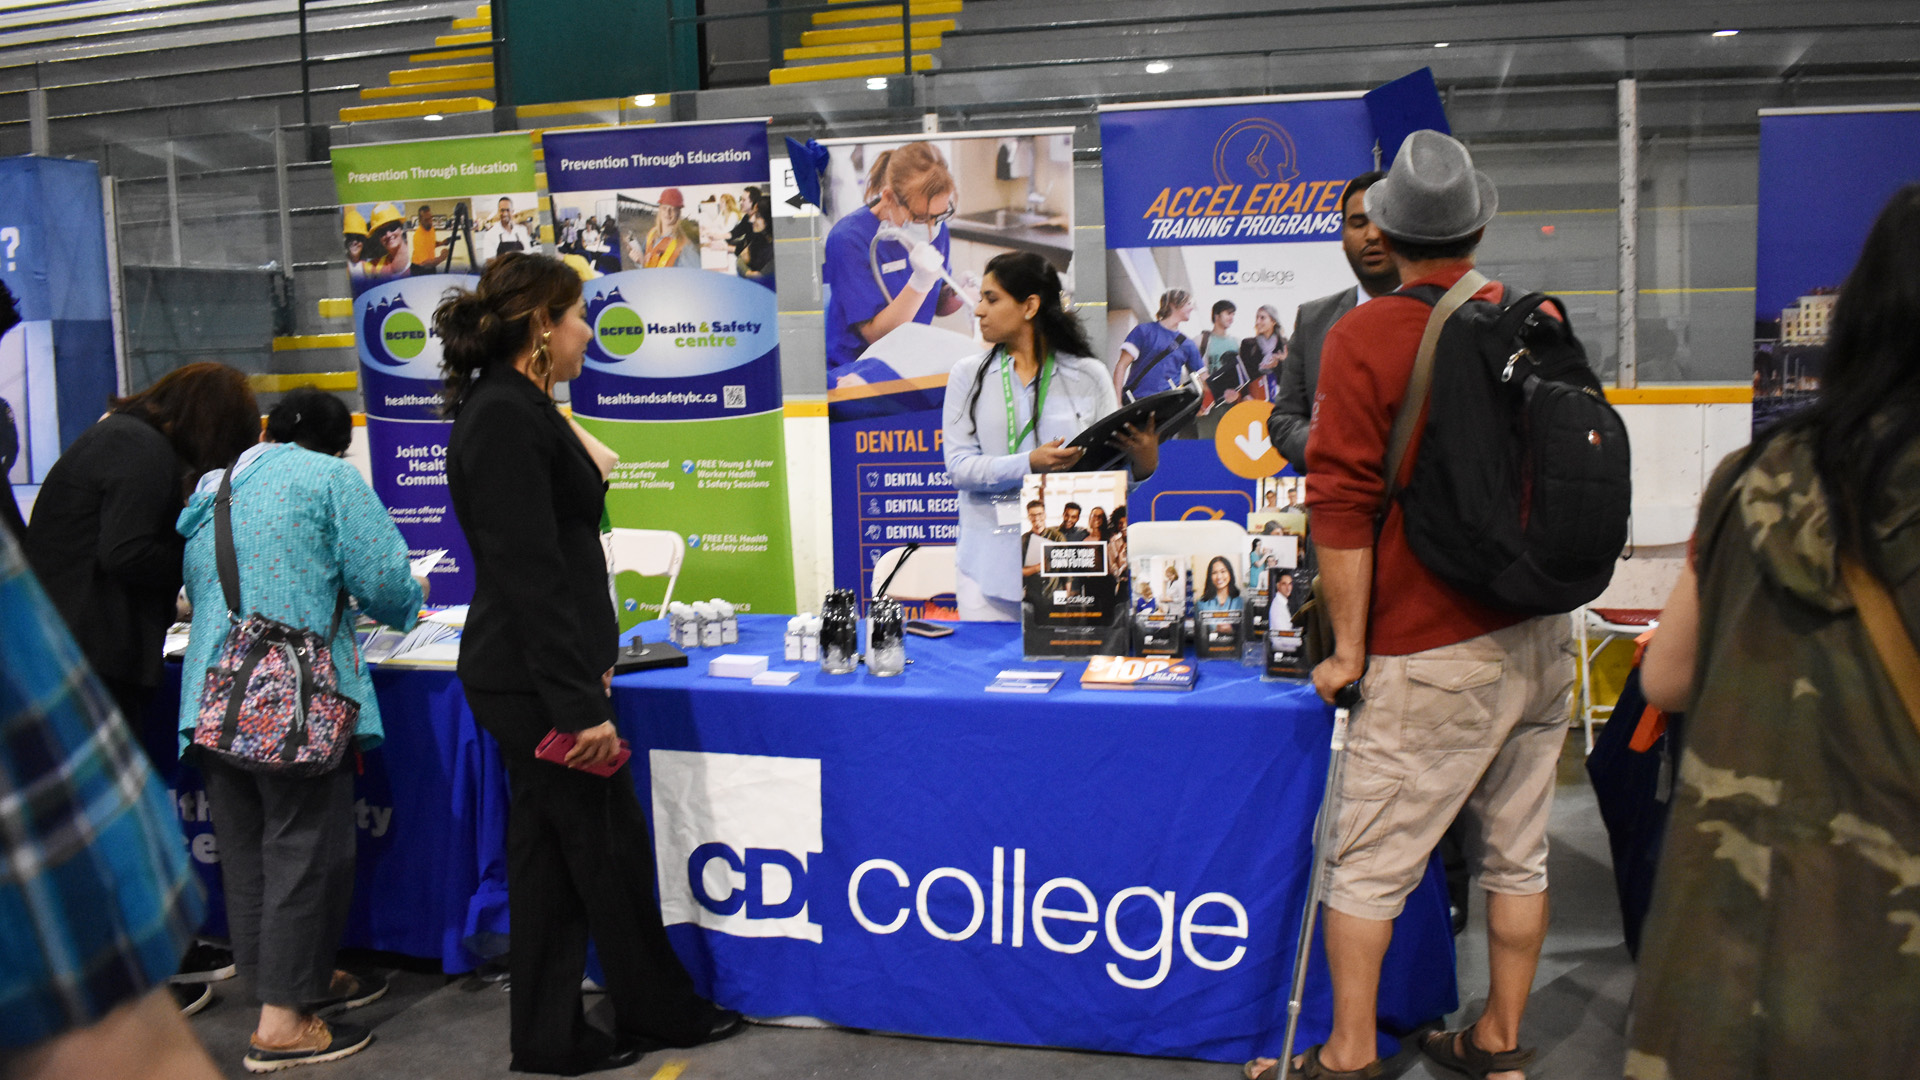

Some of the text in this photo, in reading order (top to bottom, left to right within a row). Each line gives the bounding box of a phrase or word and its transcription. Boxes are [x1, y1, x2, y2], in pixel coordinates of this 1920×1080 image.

[561, 149, 751, 171] Prevention Through Education
[348, 161, 517, 184] Prevention Through Education
[1148, 212, 1343, 240] TRAINING PROGRAMS
[600, 326, 643, 336] BCFED
[647, 320, 762, 334] Health & Safety
[386, 330, 425, 340] BCFED
[674, 334, 737, 348] centre
[597, 391, 718, 406] healthandsafetybc.ca
[855, 430, 929, 453] DENTAL
[395, 445, 429, 458] Joint
[409, 458, 446, 472] Healt
[696, 459, 774, 470] FREE Young & New
[621, 470, 628, 479] &
[629, 469, 657, 480] Safety
[697, 469, 757, 478] Worker Health
[884, 472, 924, 487] DENTAL
[640, 479, 675, 490] Training
[697, 479, 770, 490] & Safety Sessions
[885, 499, 925, 513] DENTAL
[702, 533, 723, 543] FREE
[739, 533, 768, 543] Health
[886, 525, 926, 539] DENTAL
[702, 543, 709, 551] &
[710, 543, 737, 553] Safety
[847, 846, 1249, 989] college
